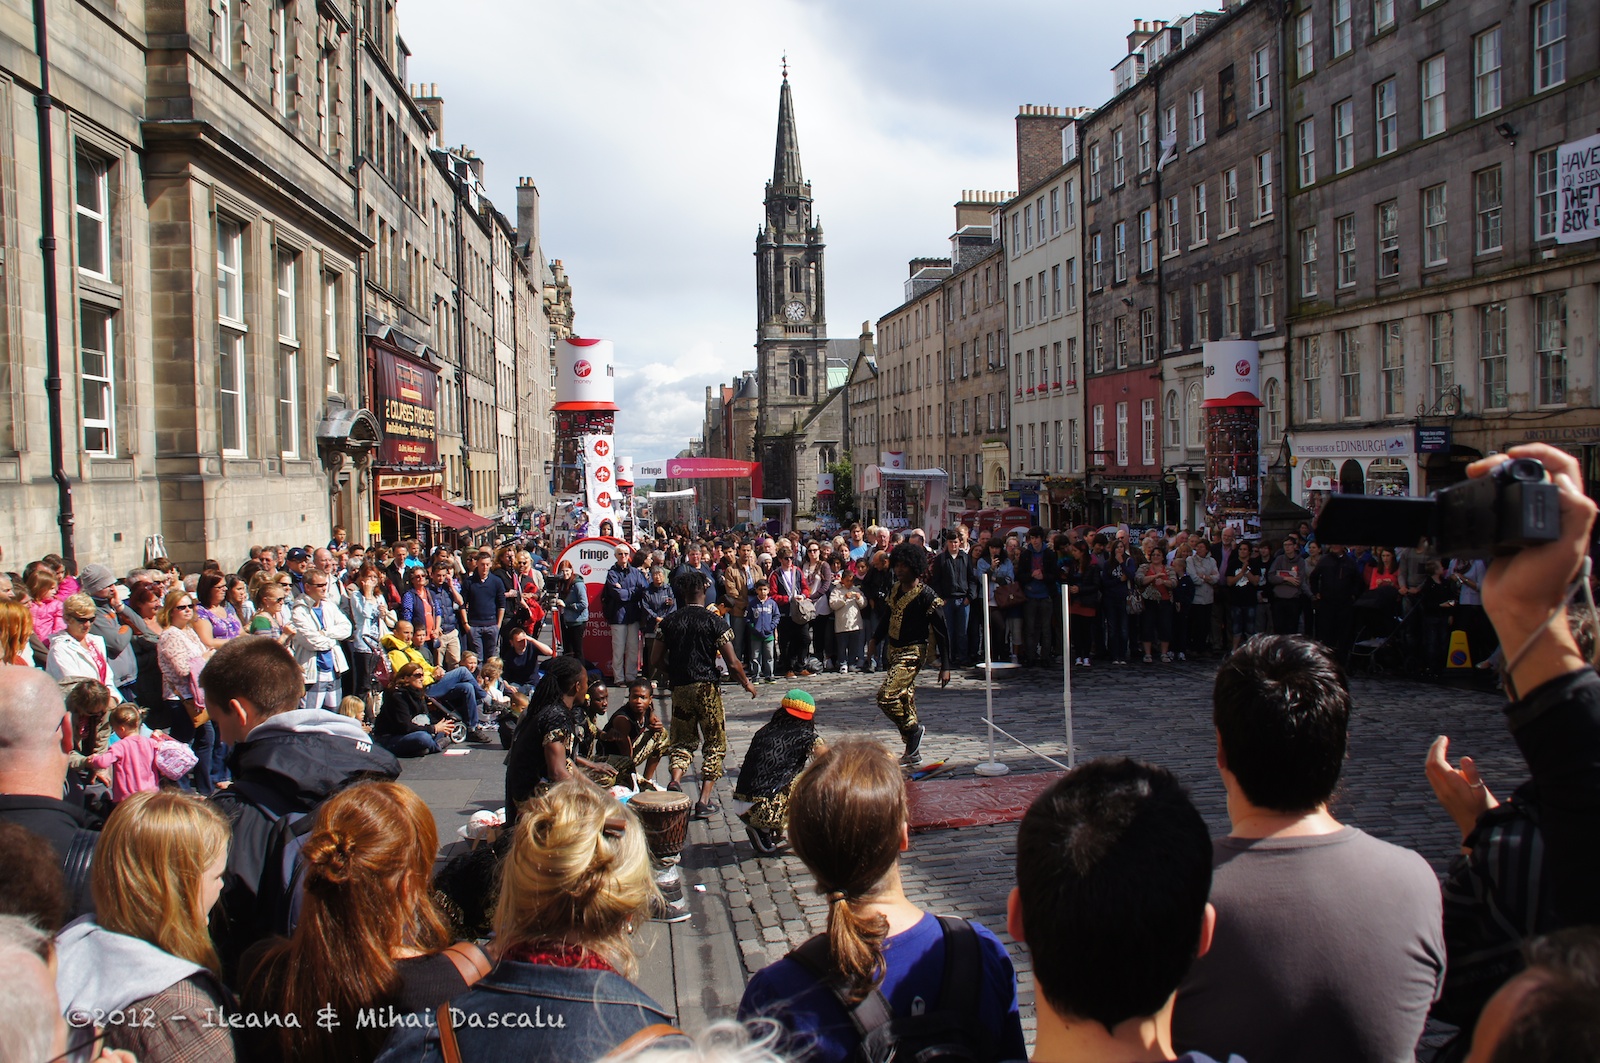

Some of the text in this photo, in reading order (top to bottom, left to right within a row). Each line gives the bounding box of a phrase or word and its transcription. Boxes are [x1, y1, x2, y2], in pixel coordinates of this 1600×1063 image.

[1562, 147, 1600, 173] HAVE
[1562, 208, 1589, 233] BOY
[1297, 445, 1305, 453] THE
[1315, 444, 1329, 452] HOUSE
[1329, 444, 1336, 452] OF
[1336, 439, 1387, 452] EDINBURGH
[641, 466, 662, 476] fringe
[579, 548, 609, 561] fringe
